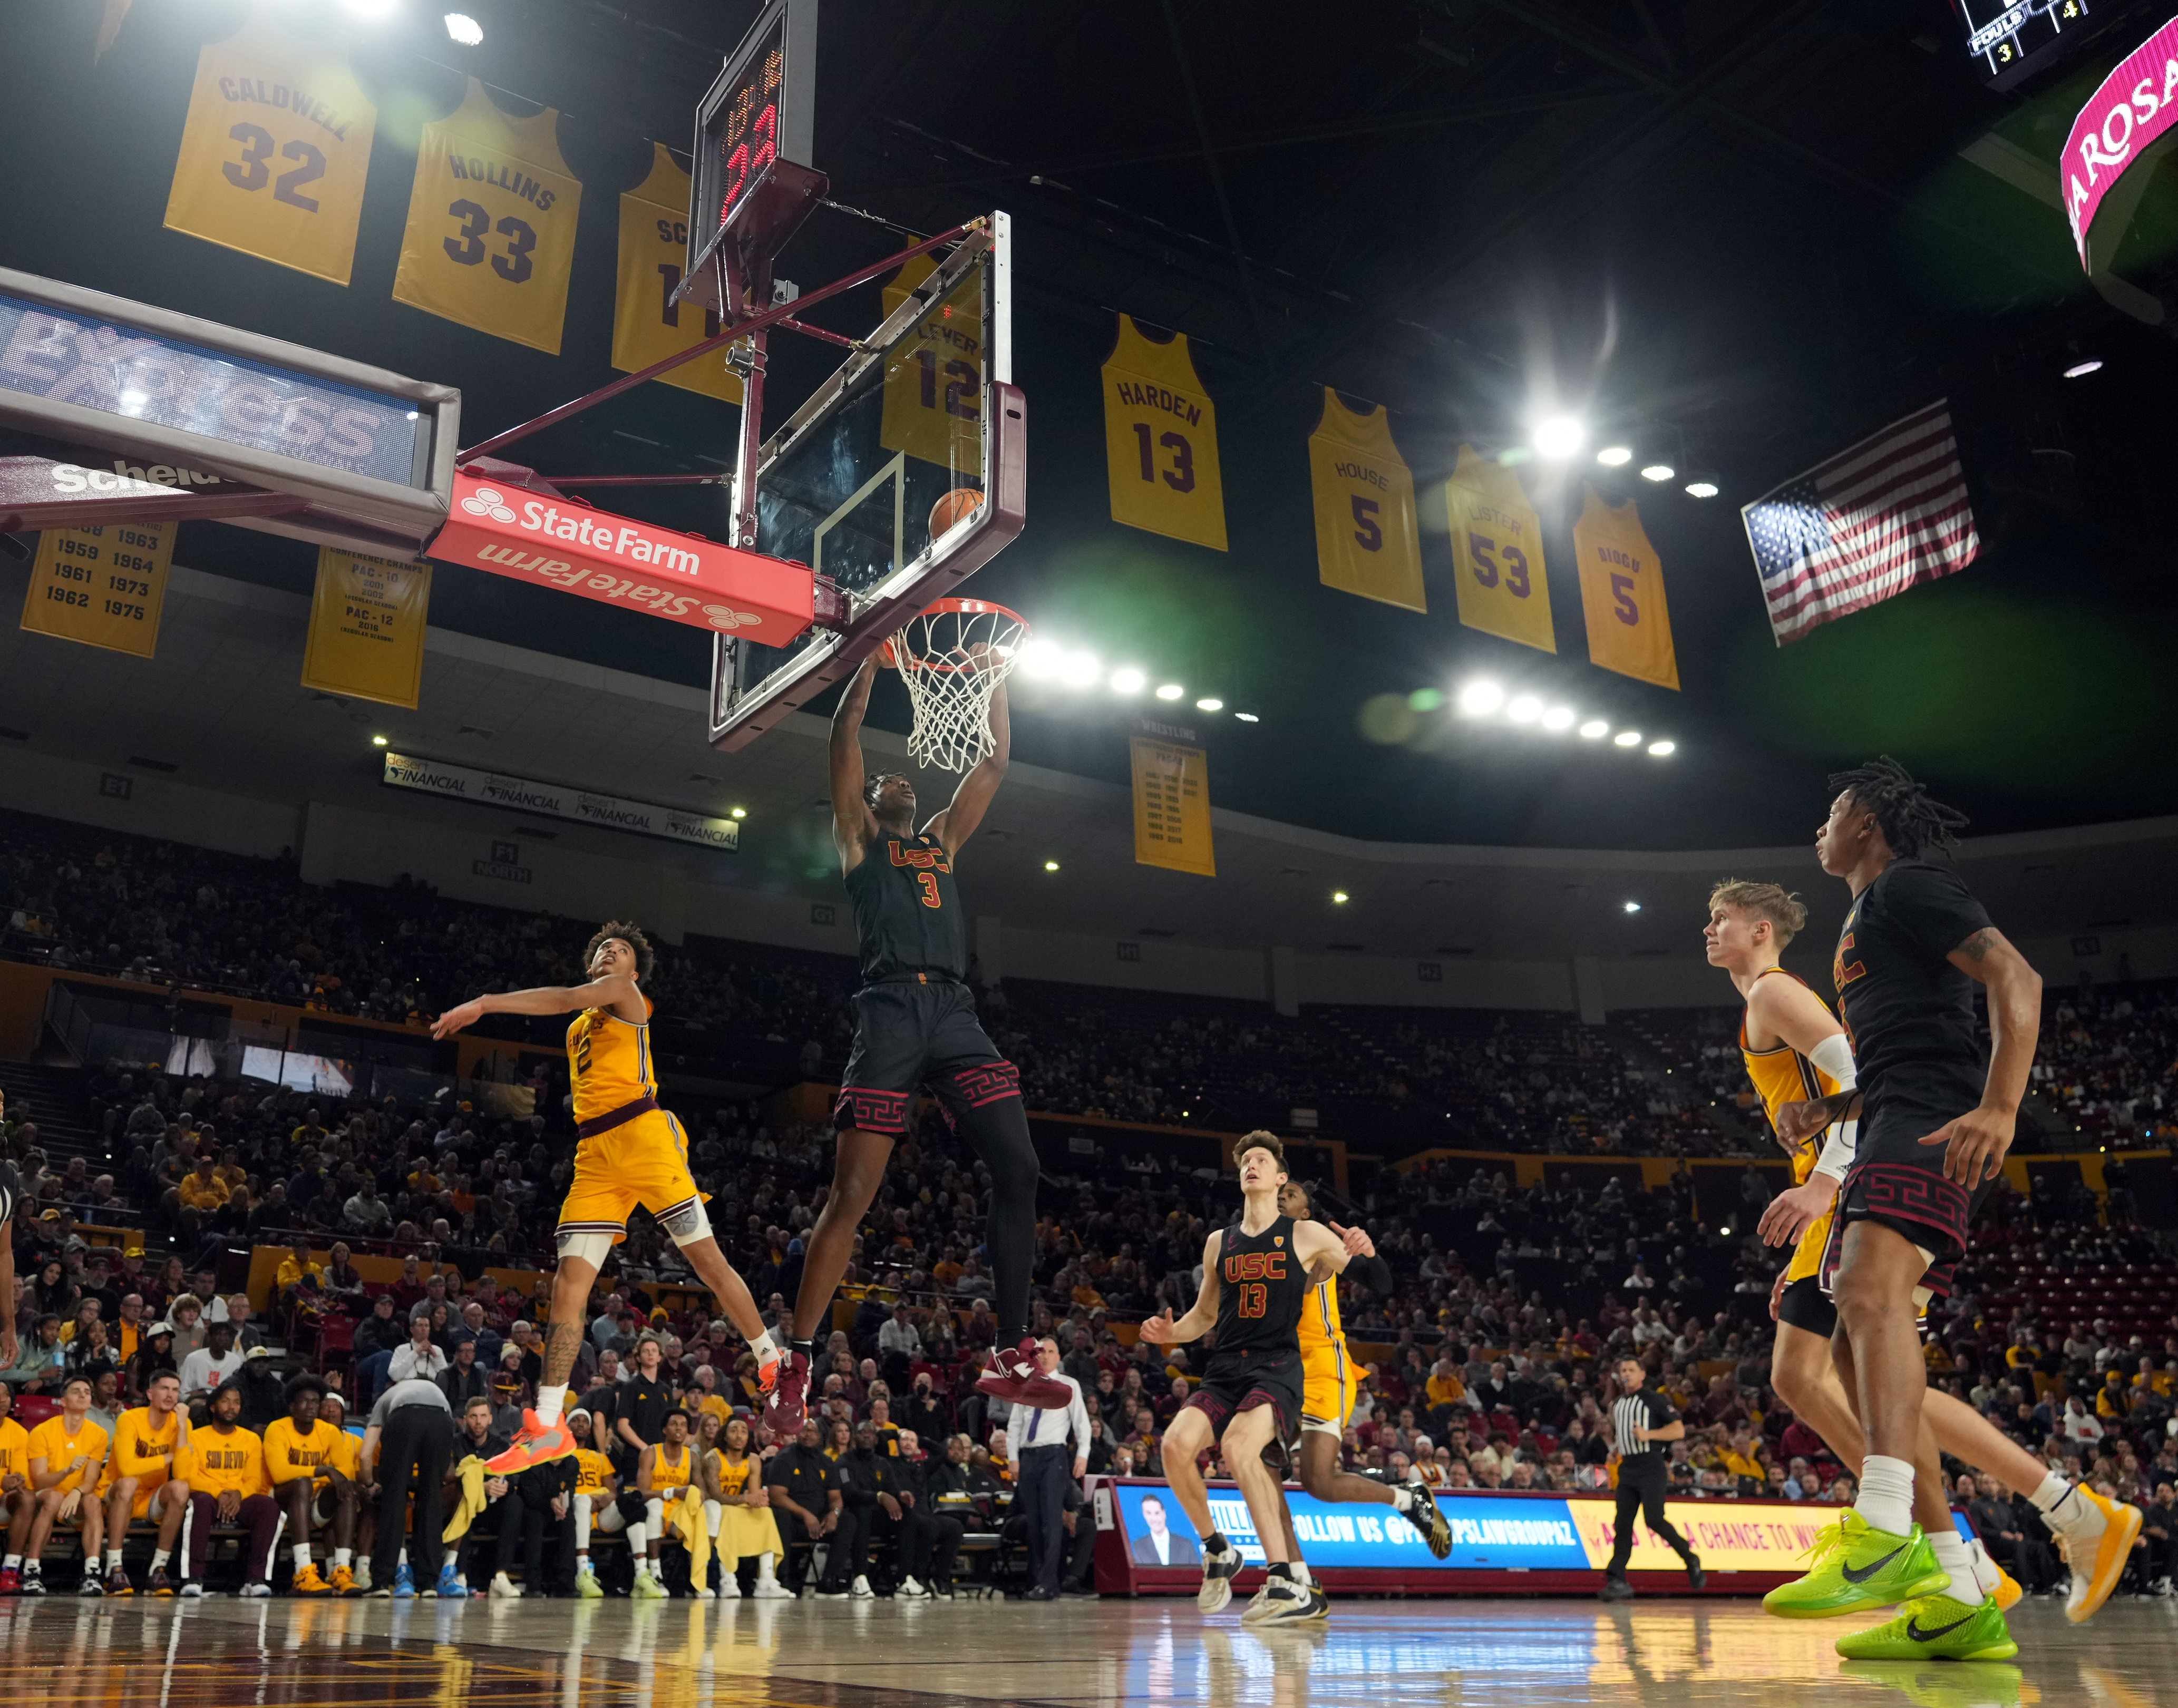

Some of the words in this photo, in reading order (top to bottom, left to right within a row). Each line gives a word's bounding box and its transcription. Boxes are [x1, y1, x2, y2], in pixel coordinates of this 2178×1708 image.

[1998, 44, 2011, 62] 3
[218, 77, 354, 143] CALDWELL
[221, 122, 327, 214] 32
[449, 155, 556, 211] HOLLINS
[443, 198, 538, 285] 33
[657, 220, 687, 243] SC
[917, 323, 978, 356] LEVER
[916, 349, 980, 421] 12
[1116, 382, 1201, 427] HARDEN
[1133, 423, 1195, 493] 13
[1335, 462, 1389, 492] HOUSE
[1350, 494, 1383, 552] 5
[1469, 503, 1521, 536] LISTER
[58, 539, 99, 560] 1959
[119, 529, 158, 550] 1963
[55, 562, 92, 583] 1961
[113, 552, 154, 573] 1964
[330, 547, 384, 565] CONFERENCE
[386, 559, 423, 573] CHAMPS
[1469, 532, 1531, 600] 53
[1597, 545, 1640, 573] DIOGU
[47, 585, 89, 608] 1962
[109, 575, 149, 597] 1973
[1609, 572, 1639, 627] 5
[105, 600, 145, 620] 1975
[346, 606, 370, 620] PAC
[382, 614, 394, 626] 12
[358, 621, 379, 632] 2016
[387, 754, 428, 772] desert
[398, 767, 465, 792] FINANCIAL
[484, 774, 525, 790] desert
[495, 787, 560, 811] FINANCIAL
[588, 805, 650, 828] FINANCIAL
[676, 822, 738, 845] FINANCIAL
[495, 845, 514, 861] F1
[888, 841, 950, 874] USC
[477, 862, 528, 882] NORTH
[918, 872, 941, 908] 3
[577, 1037, 592, 1076] 2
[1225, 1252, 1286, 1283] USC
[1238, 1283, 1267, 1317] 13
[1291, 1514, 1356, 1542] OLLOW
[1360, 1516, 1384, 1543] US
[1698, 1522, 1770, 1550] CHANCE
[1766, 1524, 1793, 1551] TO
